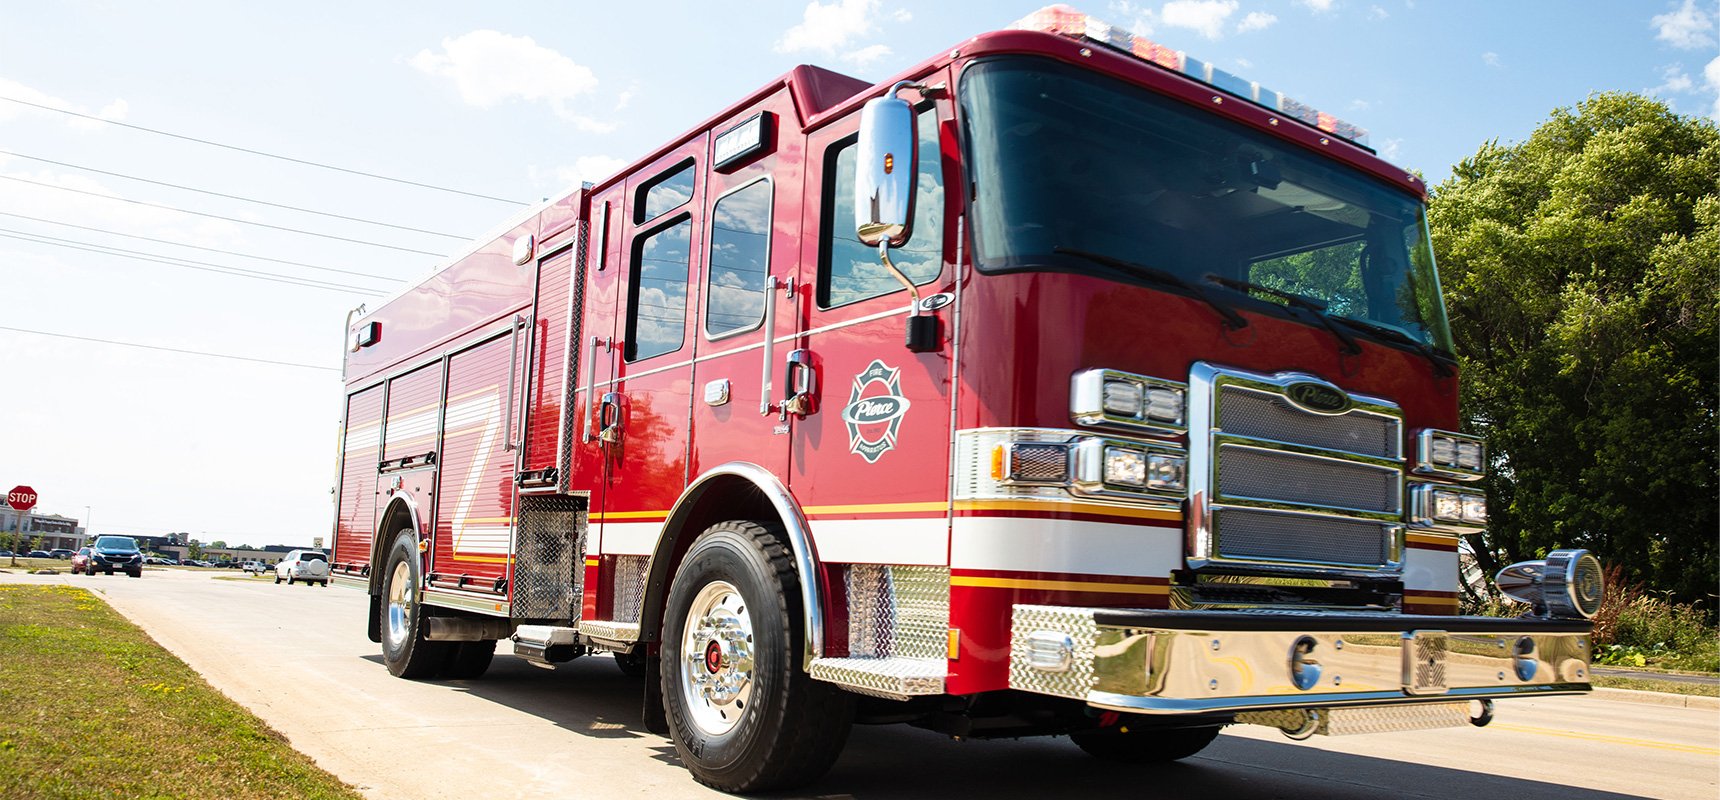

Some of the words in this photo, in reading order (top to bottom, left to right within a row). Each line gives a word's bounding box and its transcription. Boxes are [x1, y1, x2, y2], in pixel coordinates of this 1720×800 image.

[869, 368, 884, 377] FIRE
[855, 401, 894, 420] Pierce
[9, 493, 36, 503] STOP
